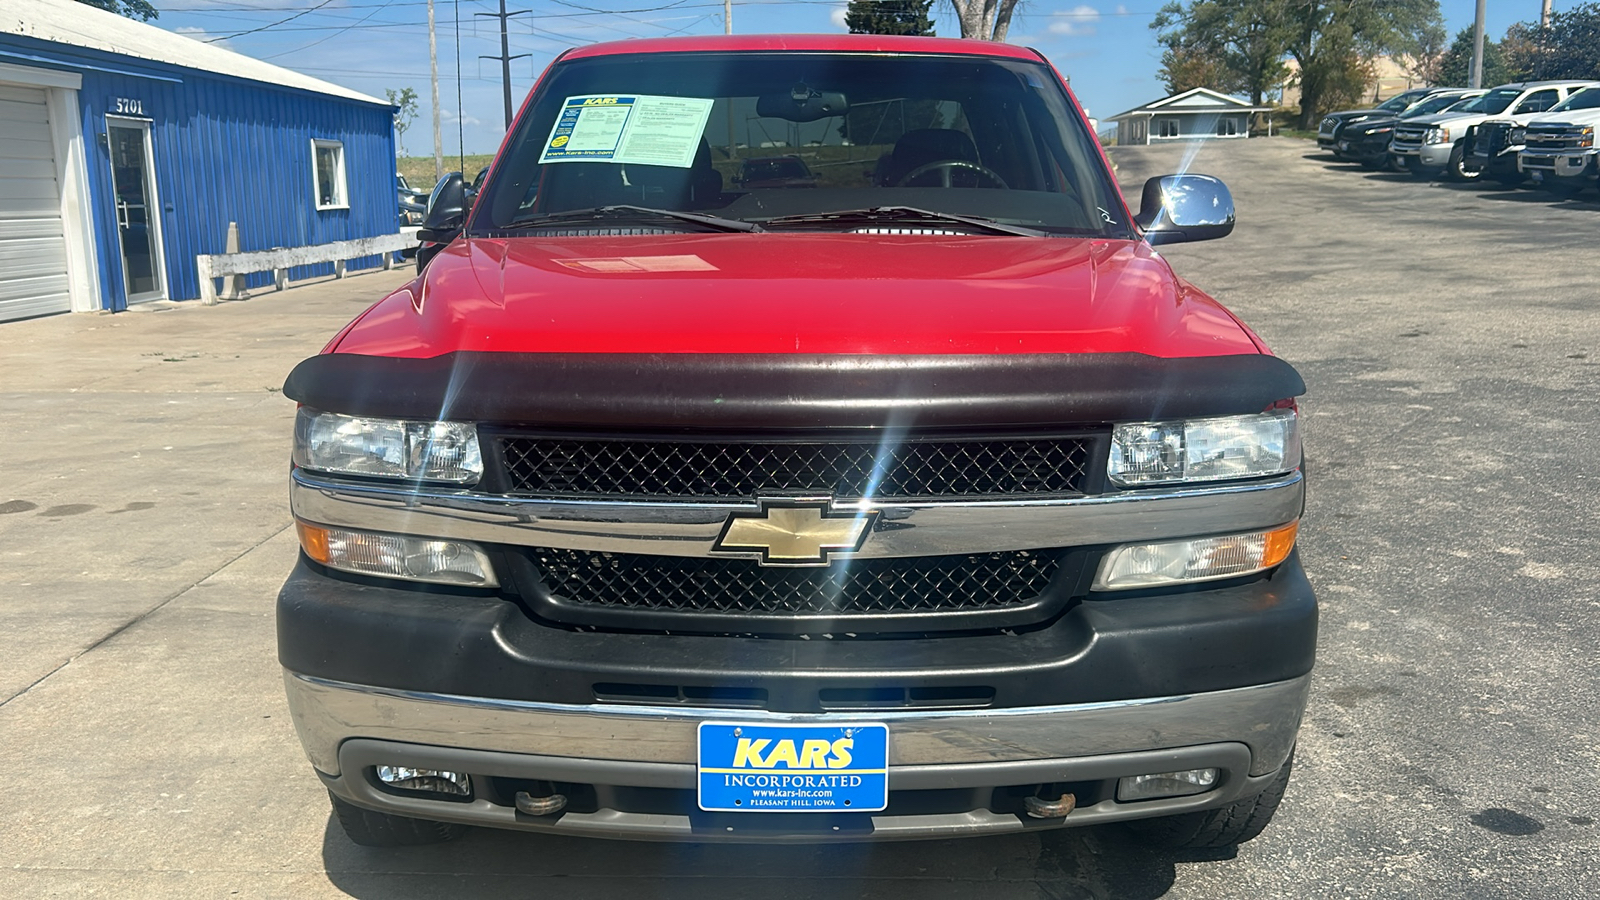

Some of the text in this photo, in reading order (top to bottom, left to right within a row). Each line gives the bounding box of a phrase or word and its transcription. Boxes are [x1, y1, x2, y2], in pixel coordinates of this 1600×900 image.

[116, 97, 143, 115] 5701
[583, 97, 619, 105] KARS
[732, 738, 854, 769] KARS
[724, 774, 862, 788] INCORPORATED
[750, 799, 788, 807] PLEASANT
[813, 799, 836, 807] IOWA
